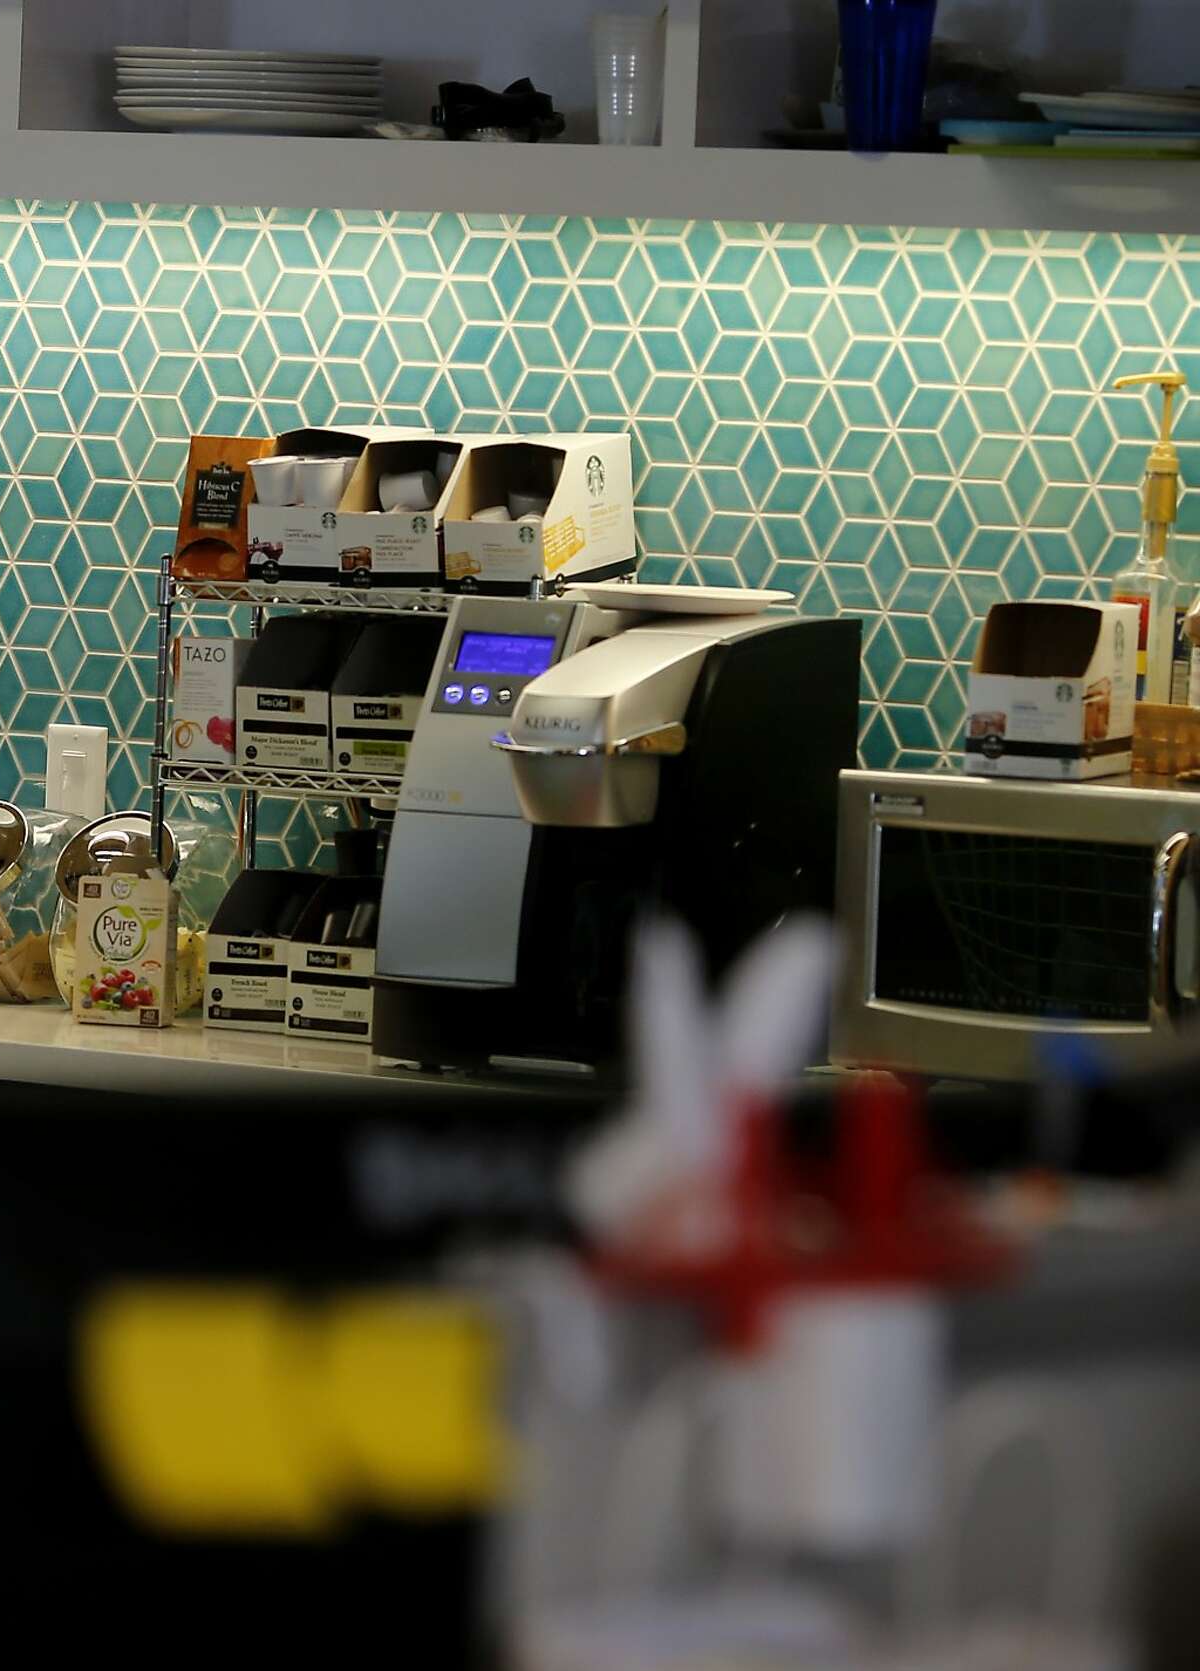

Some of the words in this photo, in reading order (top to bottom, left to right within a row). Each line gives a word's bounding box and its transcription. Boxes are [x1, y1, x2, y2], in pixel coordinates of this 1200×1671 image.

[230, 481, 242, 493] C
[207, 490, 229, 501] Blend
[183, 646, 226, 662] TAZO
[525, 716, 581, 731] KEURIG
[103, 915, 137, 932] Pure
[107, 931, 132, 947] Via
